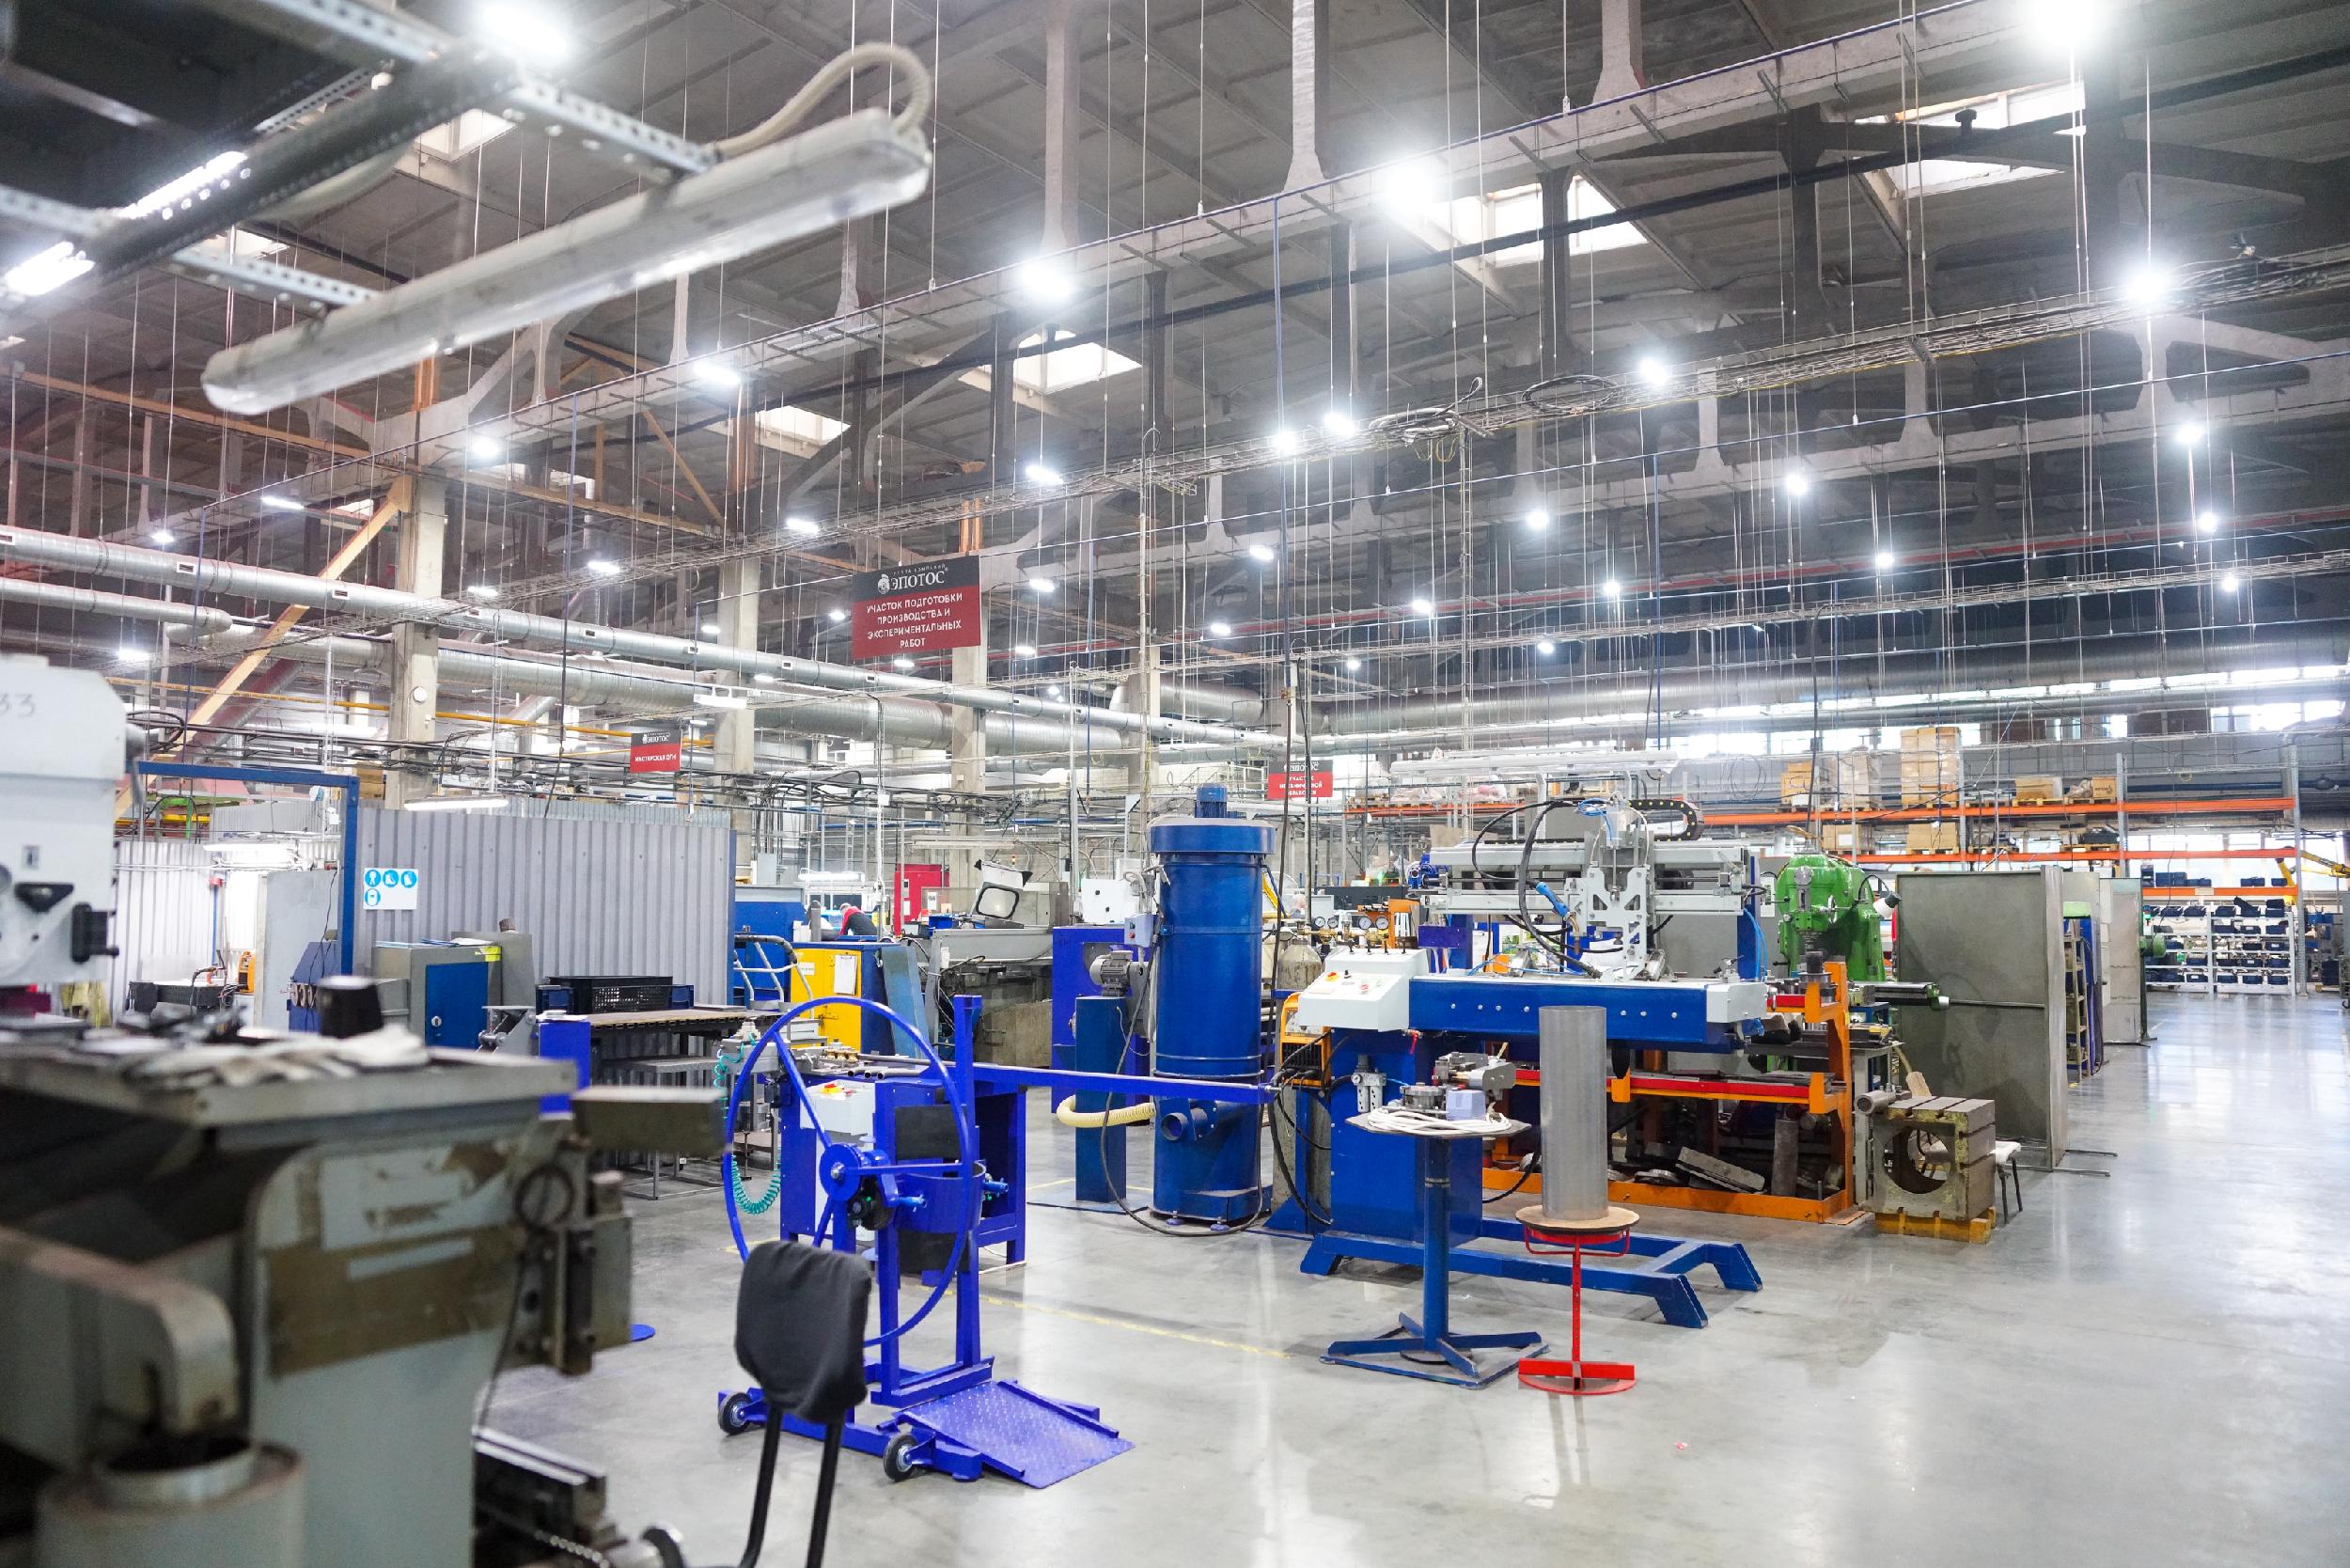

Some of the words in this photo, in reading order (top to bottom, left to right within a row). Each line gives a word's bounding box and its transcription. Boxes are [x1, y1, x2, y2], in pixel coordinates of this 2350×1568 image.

[890, 571, 946, 590] ЭПОТОС
[867, 601, 902, 614] УЧАСТОК
[904, 592, 963, 608] ПОДГОТОВКИ
[877, 609, 942, 625] ПРОИЗВОДСТВА
[944, 607, 950, 617] И
[867, 619, 962, 640] ЭКСПЕРИМЕНТАЛЬНЫХ
[900, 637, 926, 649] РАБОТ
